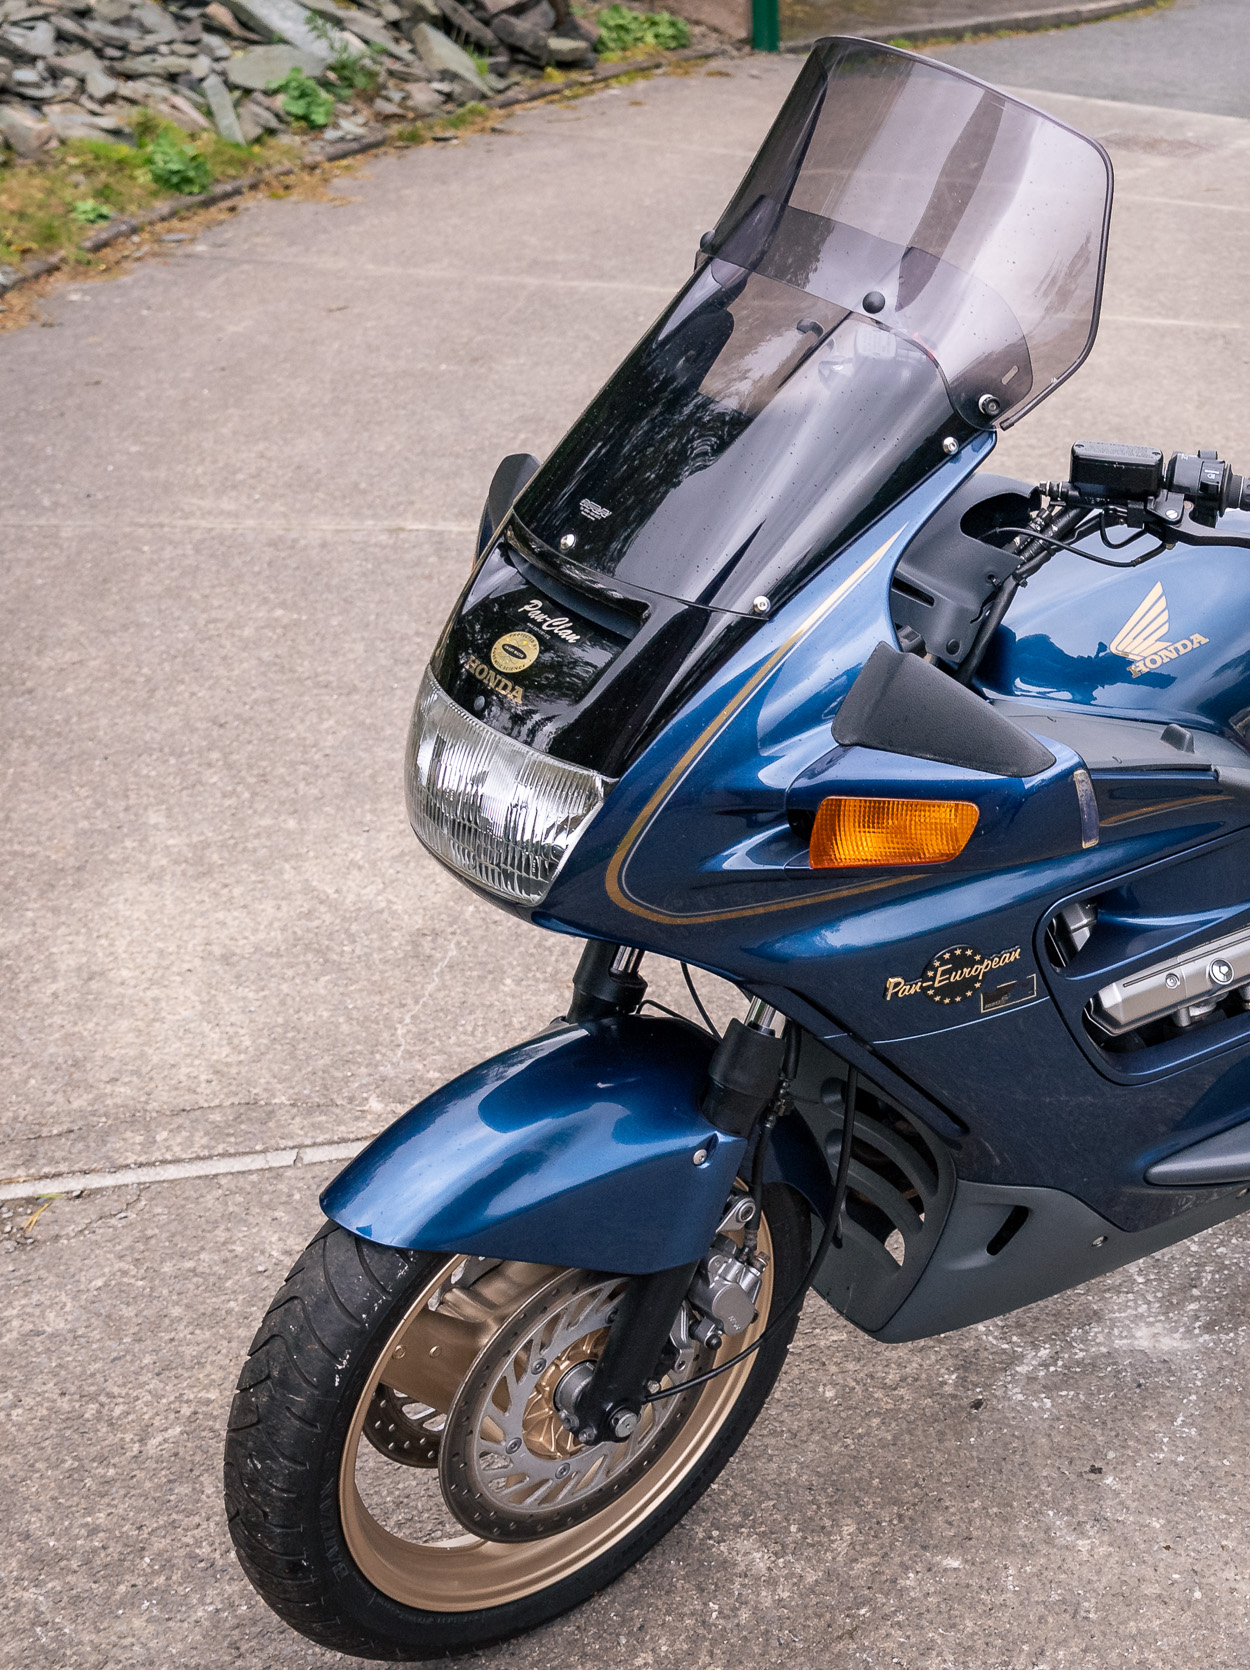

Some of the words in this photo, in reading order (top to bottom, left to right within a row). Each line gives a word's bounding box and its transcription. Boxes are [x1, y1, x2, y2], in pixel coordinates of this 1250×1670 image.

[517, 599, 581, 644] Pan-Clan
[1126, 632, 1210, 679] HONDA
[463, 655, 525, 705] HONDA
[885, 947, 1021, 1001] Pan-European
